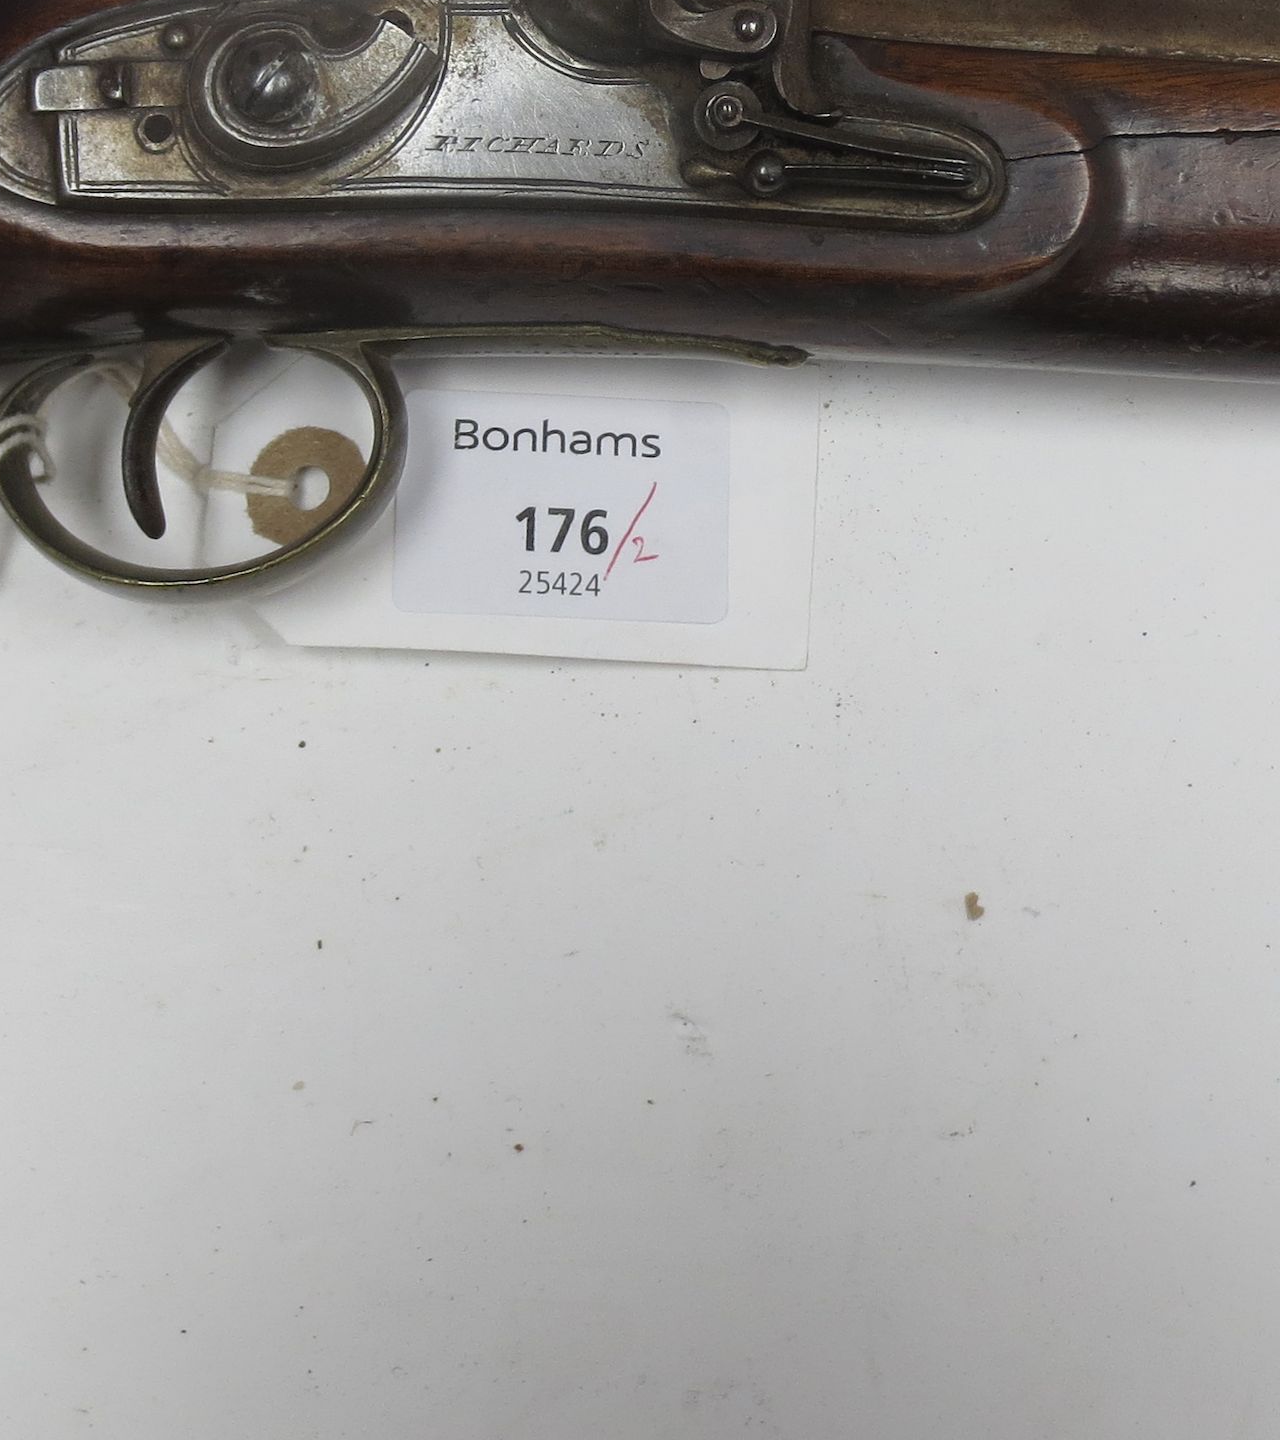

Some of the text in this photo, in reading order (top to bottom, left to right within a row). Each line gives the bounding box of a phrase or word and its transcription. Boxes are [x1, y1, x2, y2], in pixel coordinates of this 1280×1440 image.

[424, 134, 651, 159] RICHARDS
[454, 418, 662, 458] Bonhams
[518, 570, 602, 597] 25424
